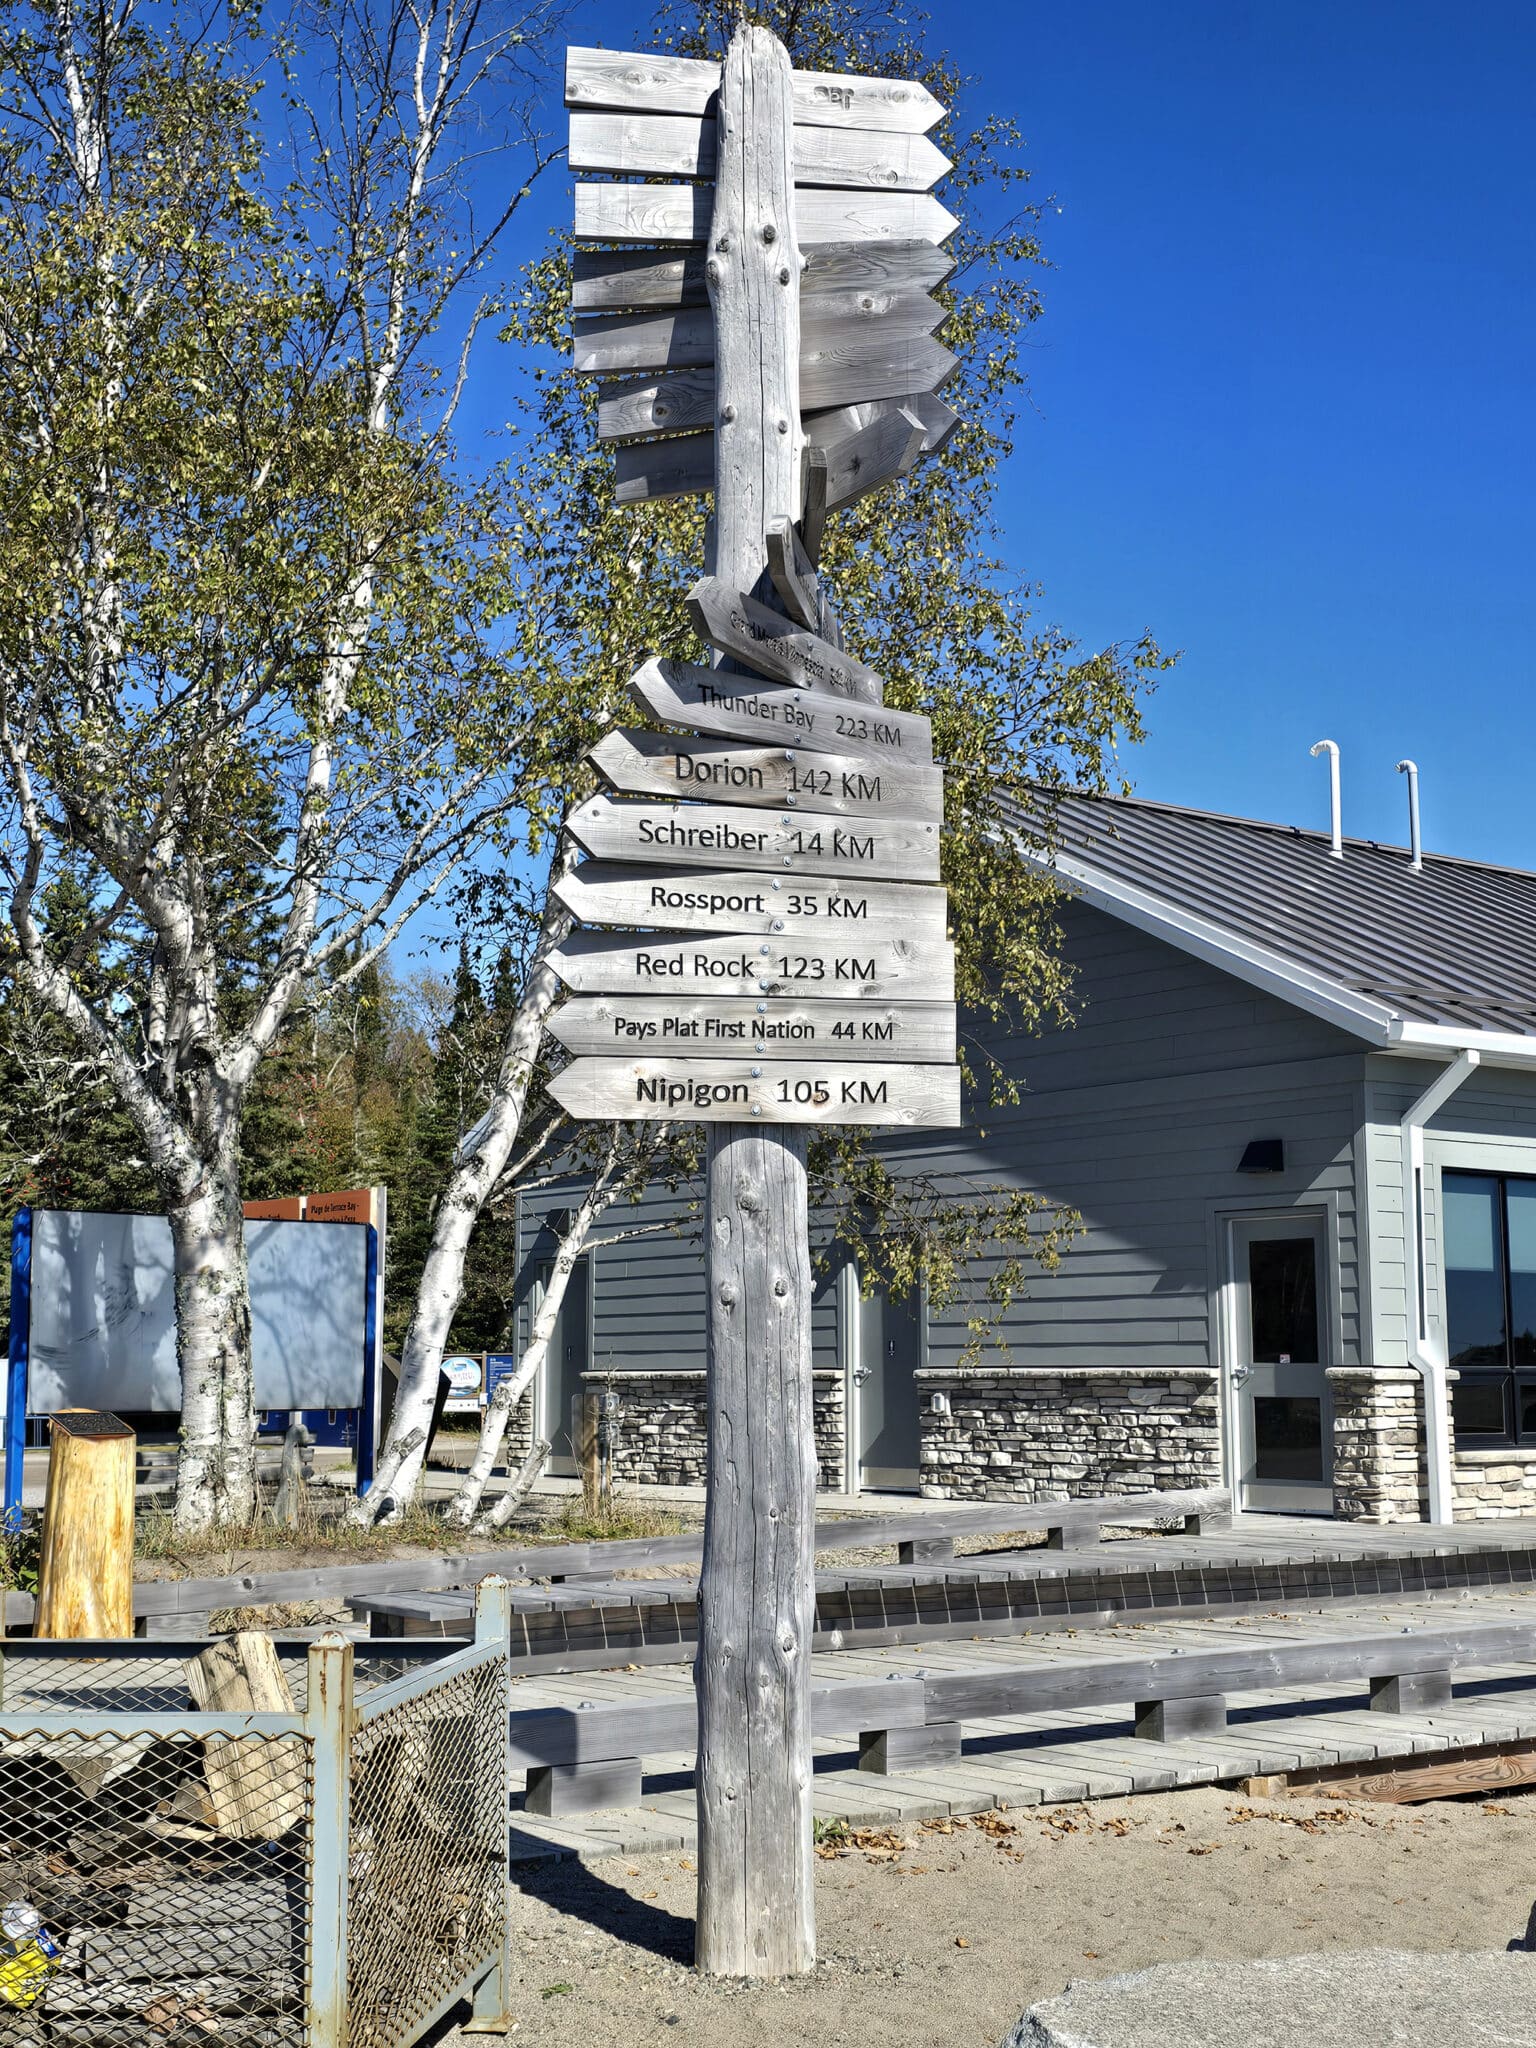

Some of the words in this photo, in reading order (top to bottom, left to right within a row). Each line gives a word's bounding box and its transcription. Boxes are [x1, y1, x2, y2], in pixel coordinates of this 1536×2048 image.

[697, 684, 778, 721] Thunder
[785, 703, 814, 732] Bay
[835, 715, 868, 740] 223
[874, 722, 902, 748] KM
[675, 752, 763, 790] Dorion
[788, 766, 833, 796] 142
[842, 772, 881, 802] KM
[638, 819, 769, 852] Schreiber
[792, 831, 824, 855] 14
[833, 832, 875, 860] KM
[651, 886, 765, 915] Rossport
[787, 895, 818, 916] 35
[828, 897, 867, 919] KM
[636, 953, 684, 977] Red
[694, 954, 755, 978] Rock
[777, 956, 826, 980] 123
[835, 958, 876, 980] KM
[614, 1017, 657, 1041] Pays
[662, 1018, 700, 1038] Plat
[705, 1018, 746, 1039] First
[752, 1020, 815, 1039] Nation
[831, 1021, 856, 1040] 44
[862, 1022, 893, 1041] KM
[636, 1078, 749, 1107] Nipigon
[776, 1079, 830, 1104] 105
[841, 1080, 888, 1104] KM
